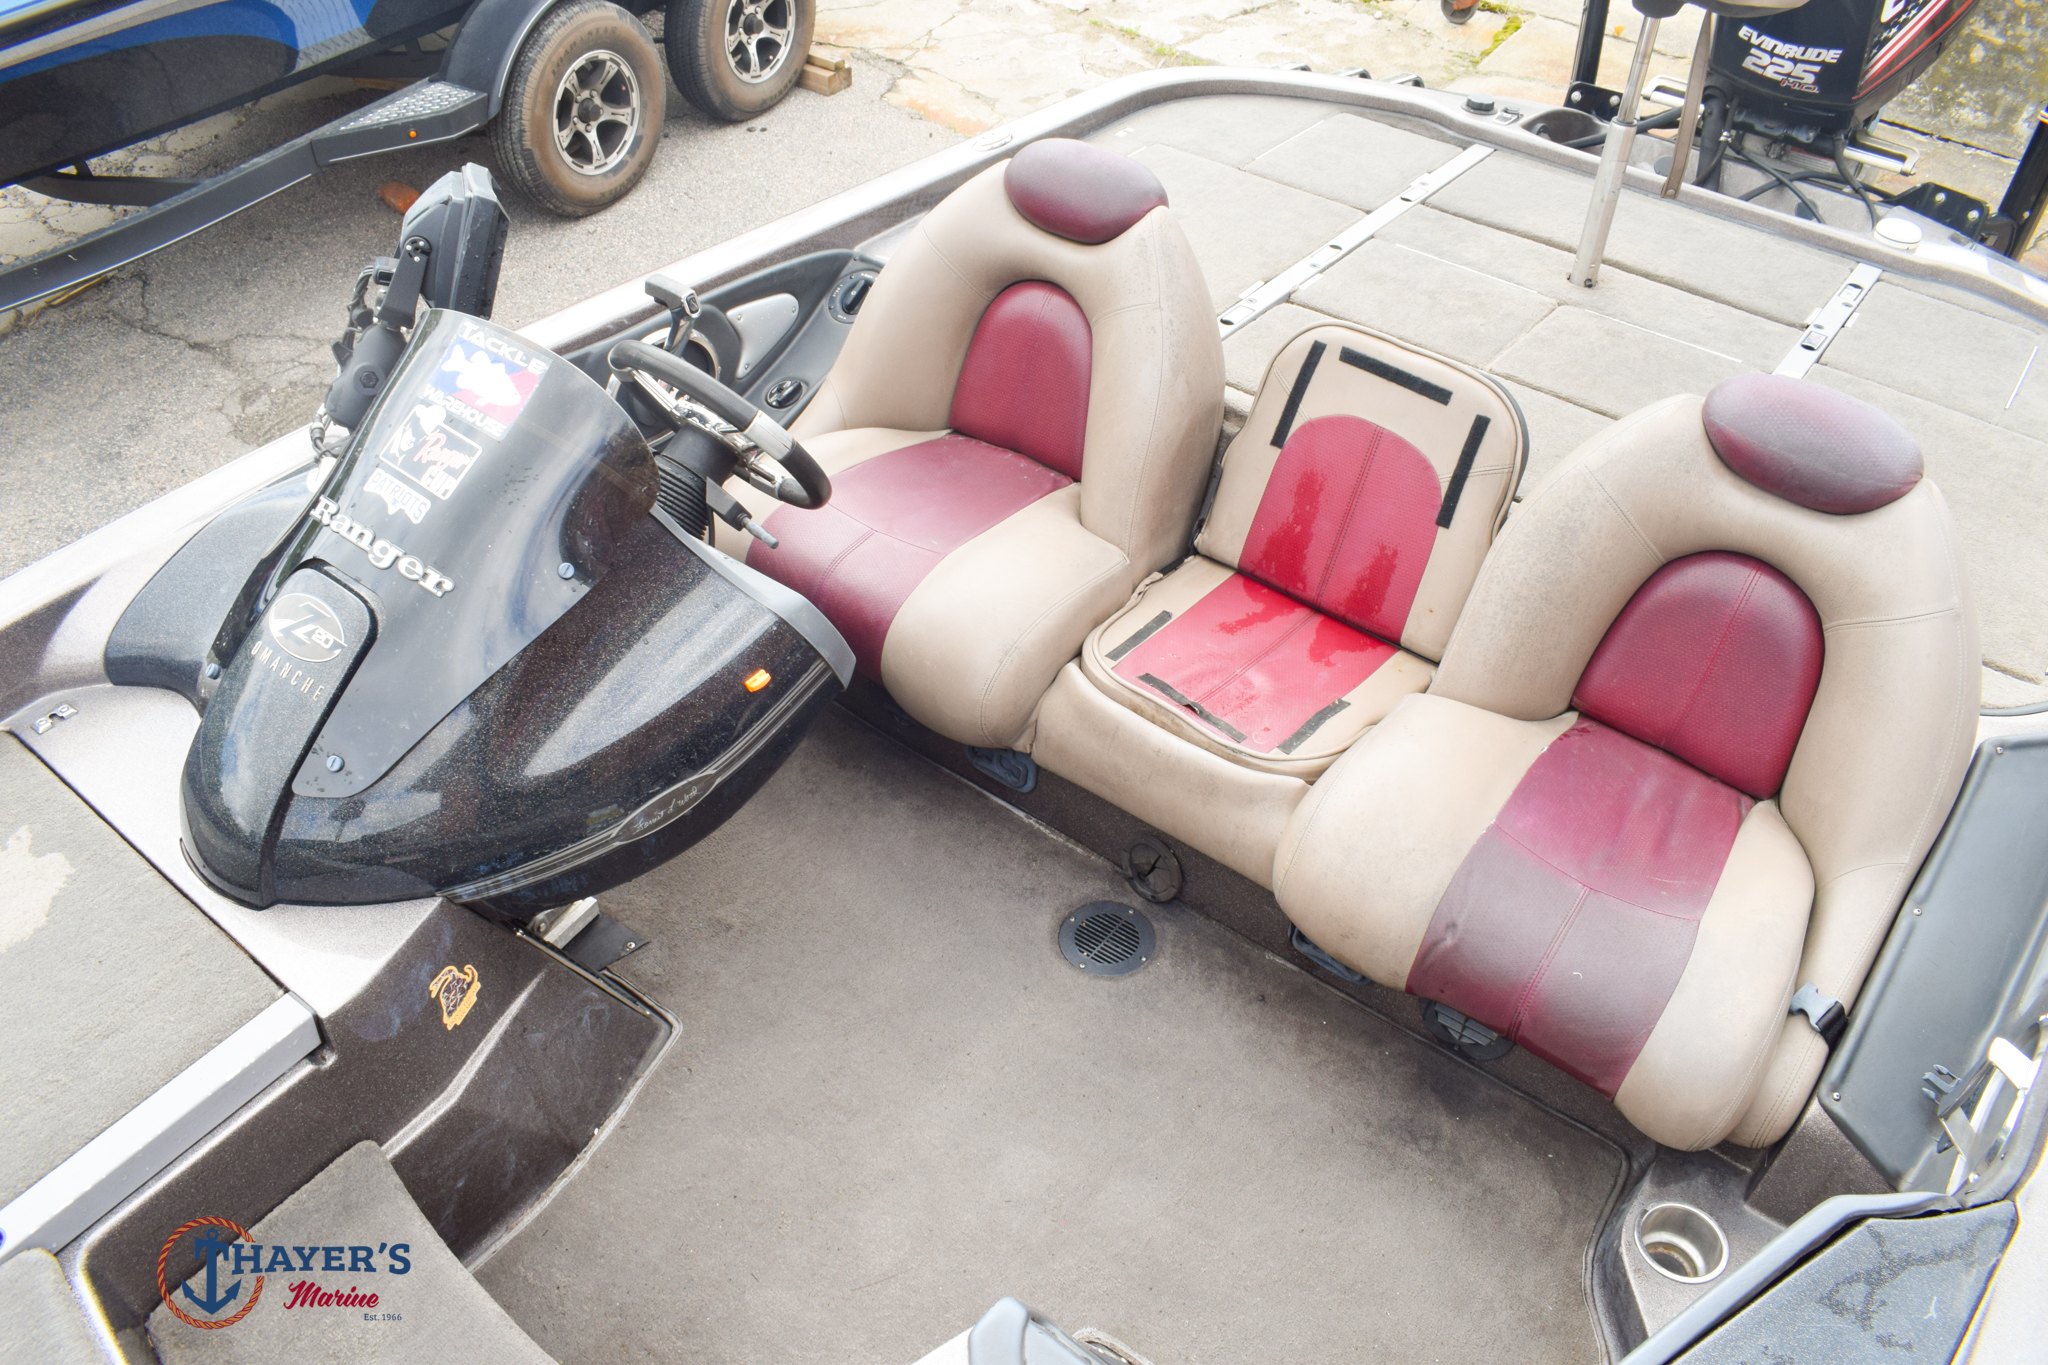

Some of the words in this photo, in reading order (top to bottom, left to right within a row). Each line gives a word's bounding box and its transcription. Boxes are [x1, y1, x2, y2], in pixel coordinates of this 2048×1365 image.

[1738, 25, 1844, 63] EVINRUDE
[1741, 48, 1822, 84] 225
[461, 320, 548, 376] TACKLE
[422, 383, 508, 438] WAREHOUSE
[413, 432, 473, 470] Ranger
[369, 470, 429, 521] PATRIOTS
[420, 465, 459, 500] CUP
[309, 494, 455, 599] Ranger
